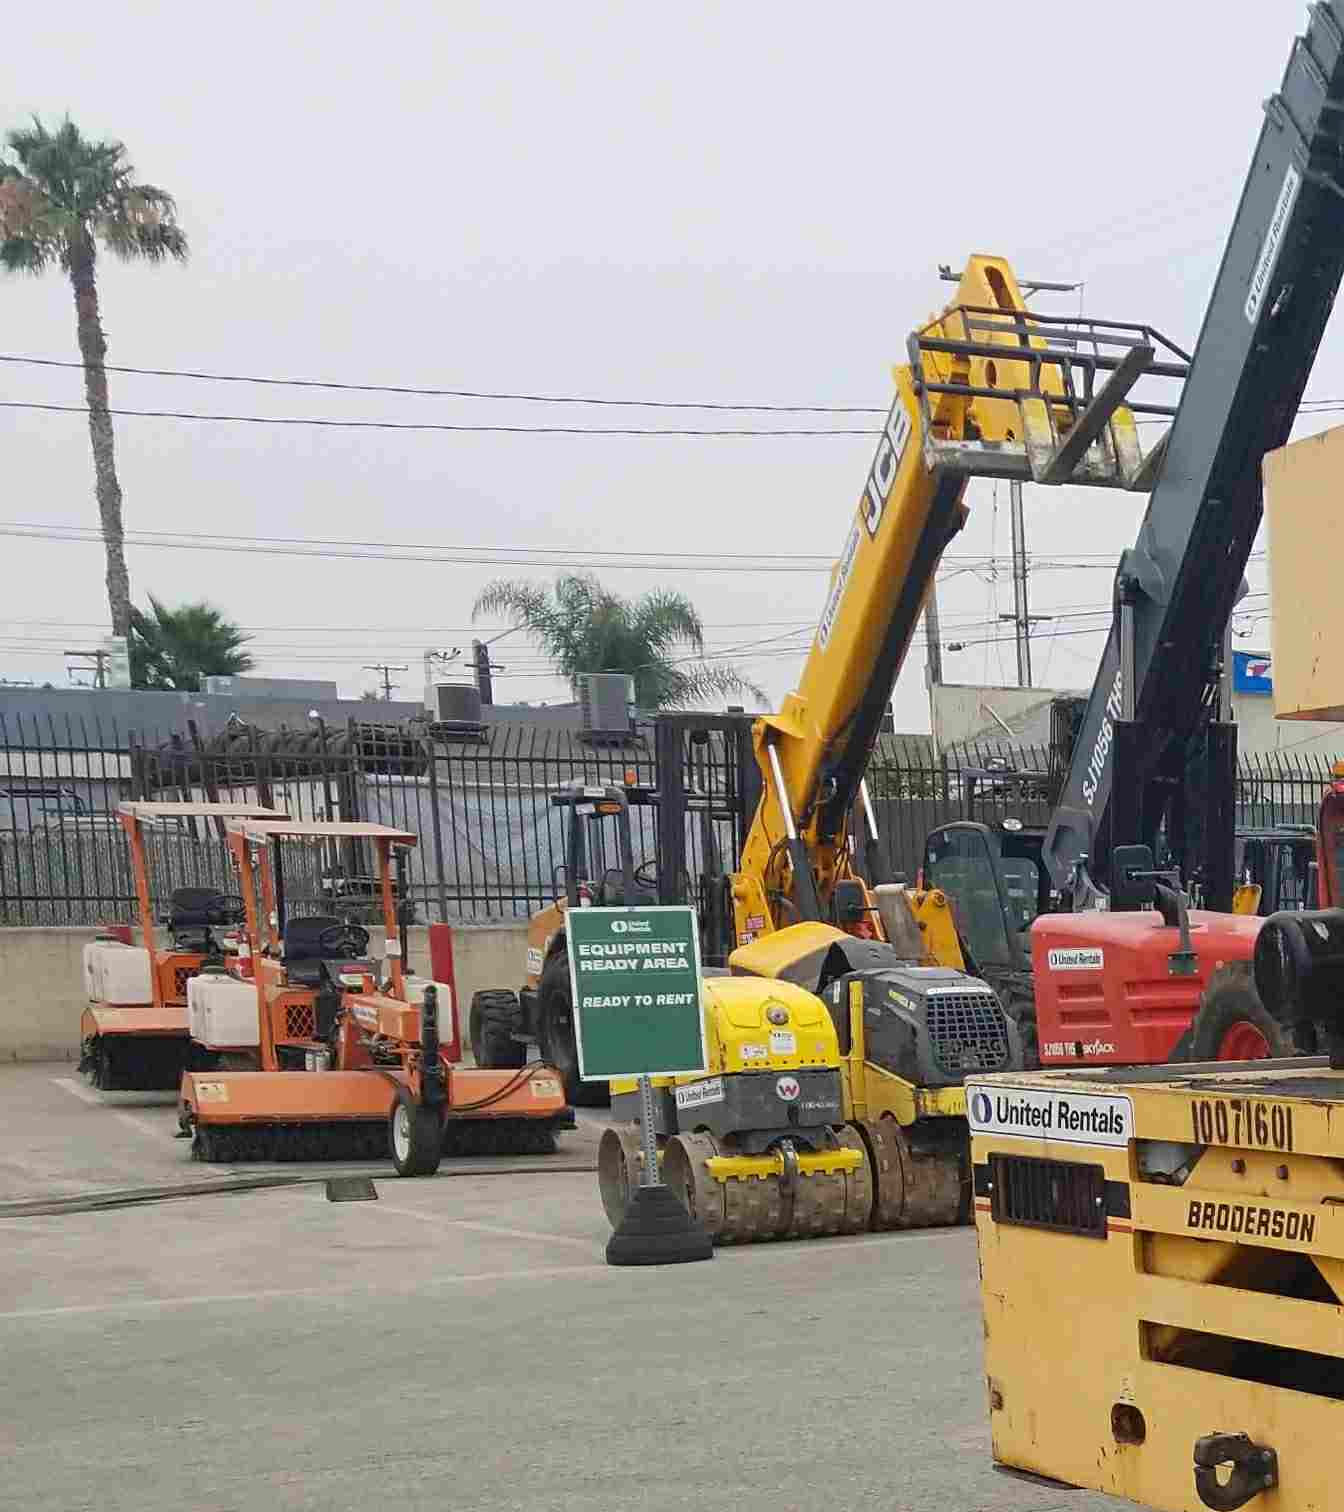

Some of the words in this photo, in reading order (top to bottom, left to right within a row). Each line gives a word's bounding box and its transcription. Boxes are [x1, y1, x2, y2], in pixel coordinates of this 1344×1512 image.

[1082, 717, 1113, 805] SJ1056
[578, 942, 688, 957] EQUIPMENT
[580, 959, 638, 971] READY
[642, 957, 689, 969] AREA
[583, 996, 631, 1008] READY
[634, 995, 652, 1006] TO
[656, 993, 694, 1006] RENT
[996, 1096, 1052, 1128] United
[1057, 1096, 1124, 1135] Rentals
[1192, 1100, 1294, 1151] 10071601
[1187, 1201, 1316, 1243] BRODERSON
